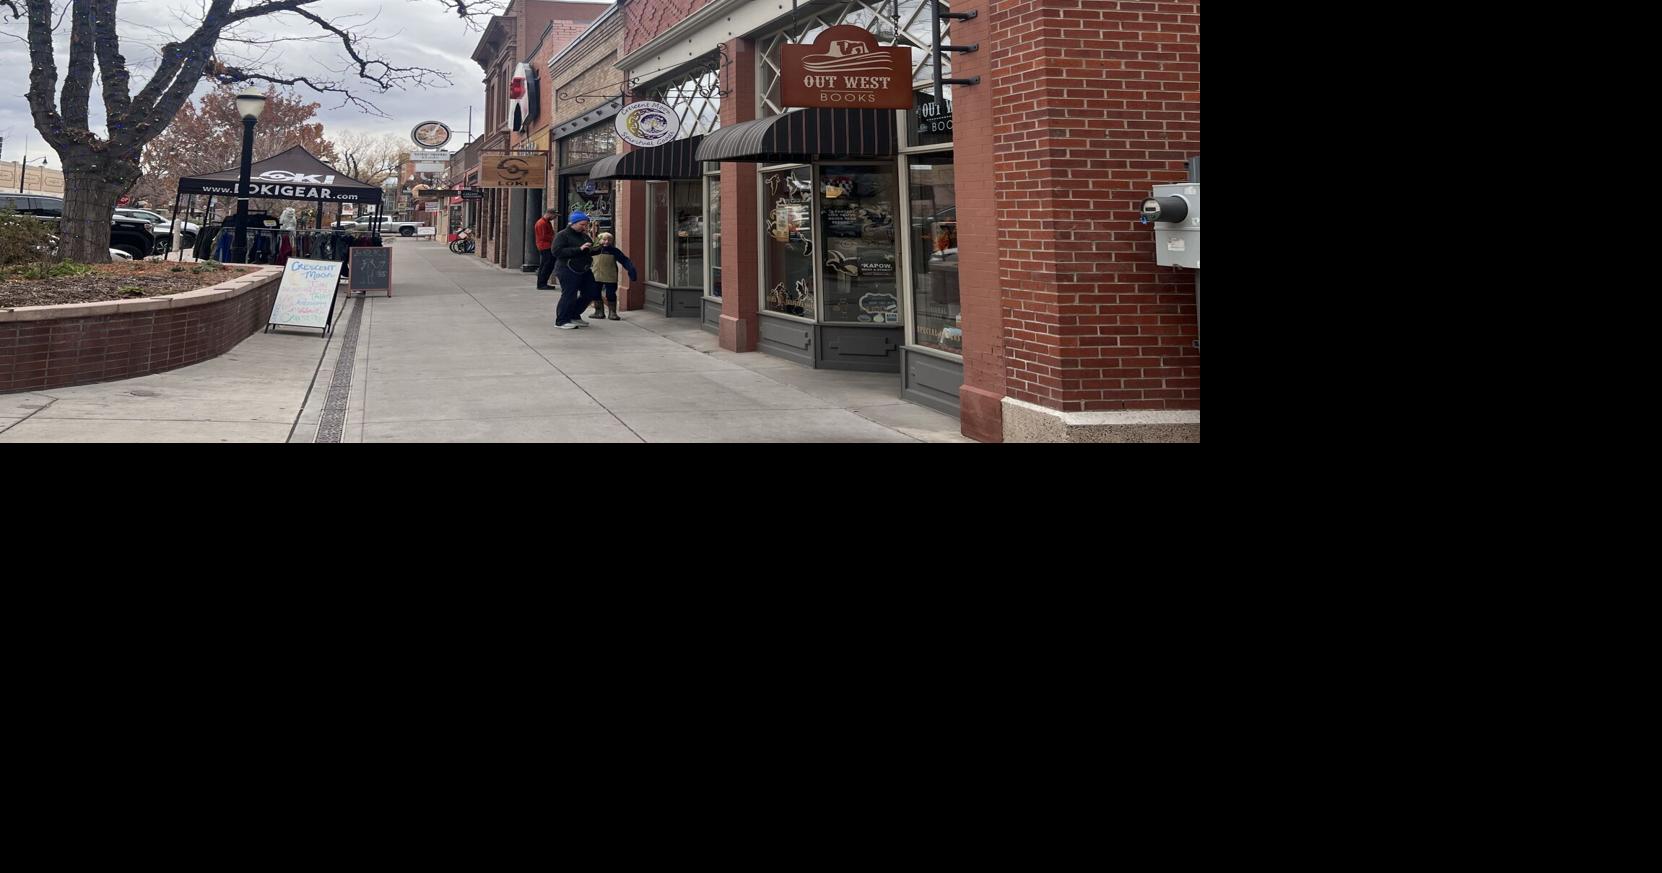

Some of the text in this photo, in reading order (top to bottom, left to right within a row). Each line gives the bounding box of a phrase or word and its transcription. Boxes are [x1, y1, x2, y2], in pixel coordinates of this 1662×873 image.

[804, 76, 890, 89] OUT WEST
[820, 93, 876, 103] BOOKS
[922, 102, 941, 118] OUT
[931, 119, 953, 132] BOO
[238, 170, 335, 185] OKI
